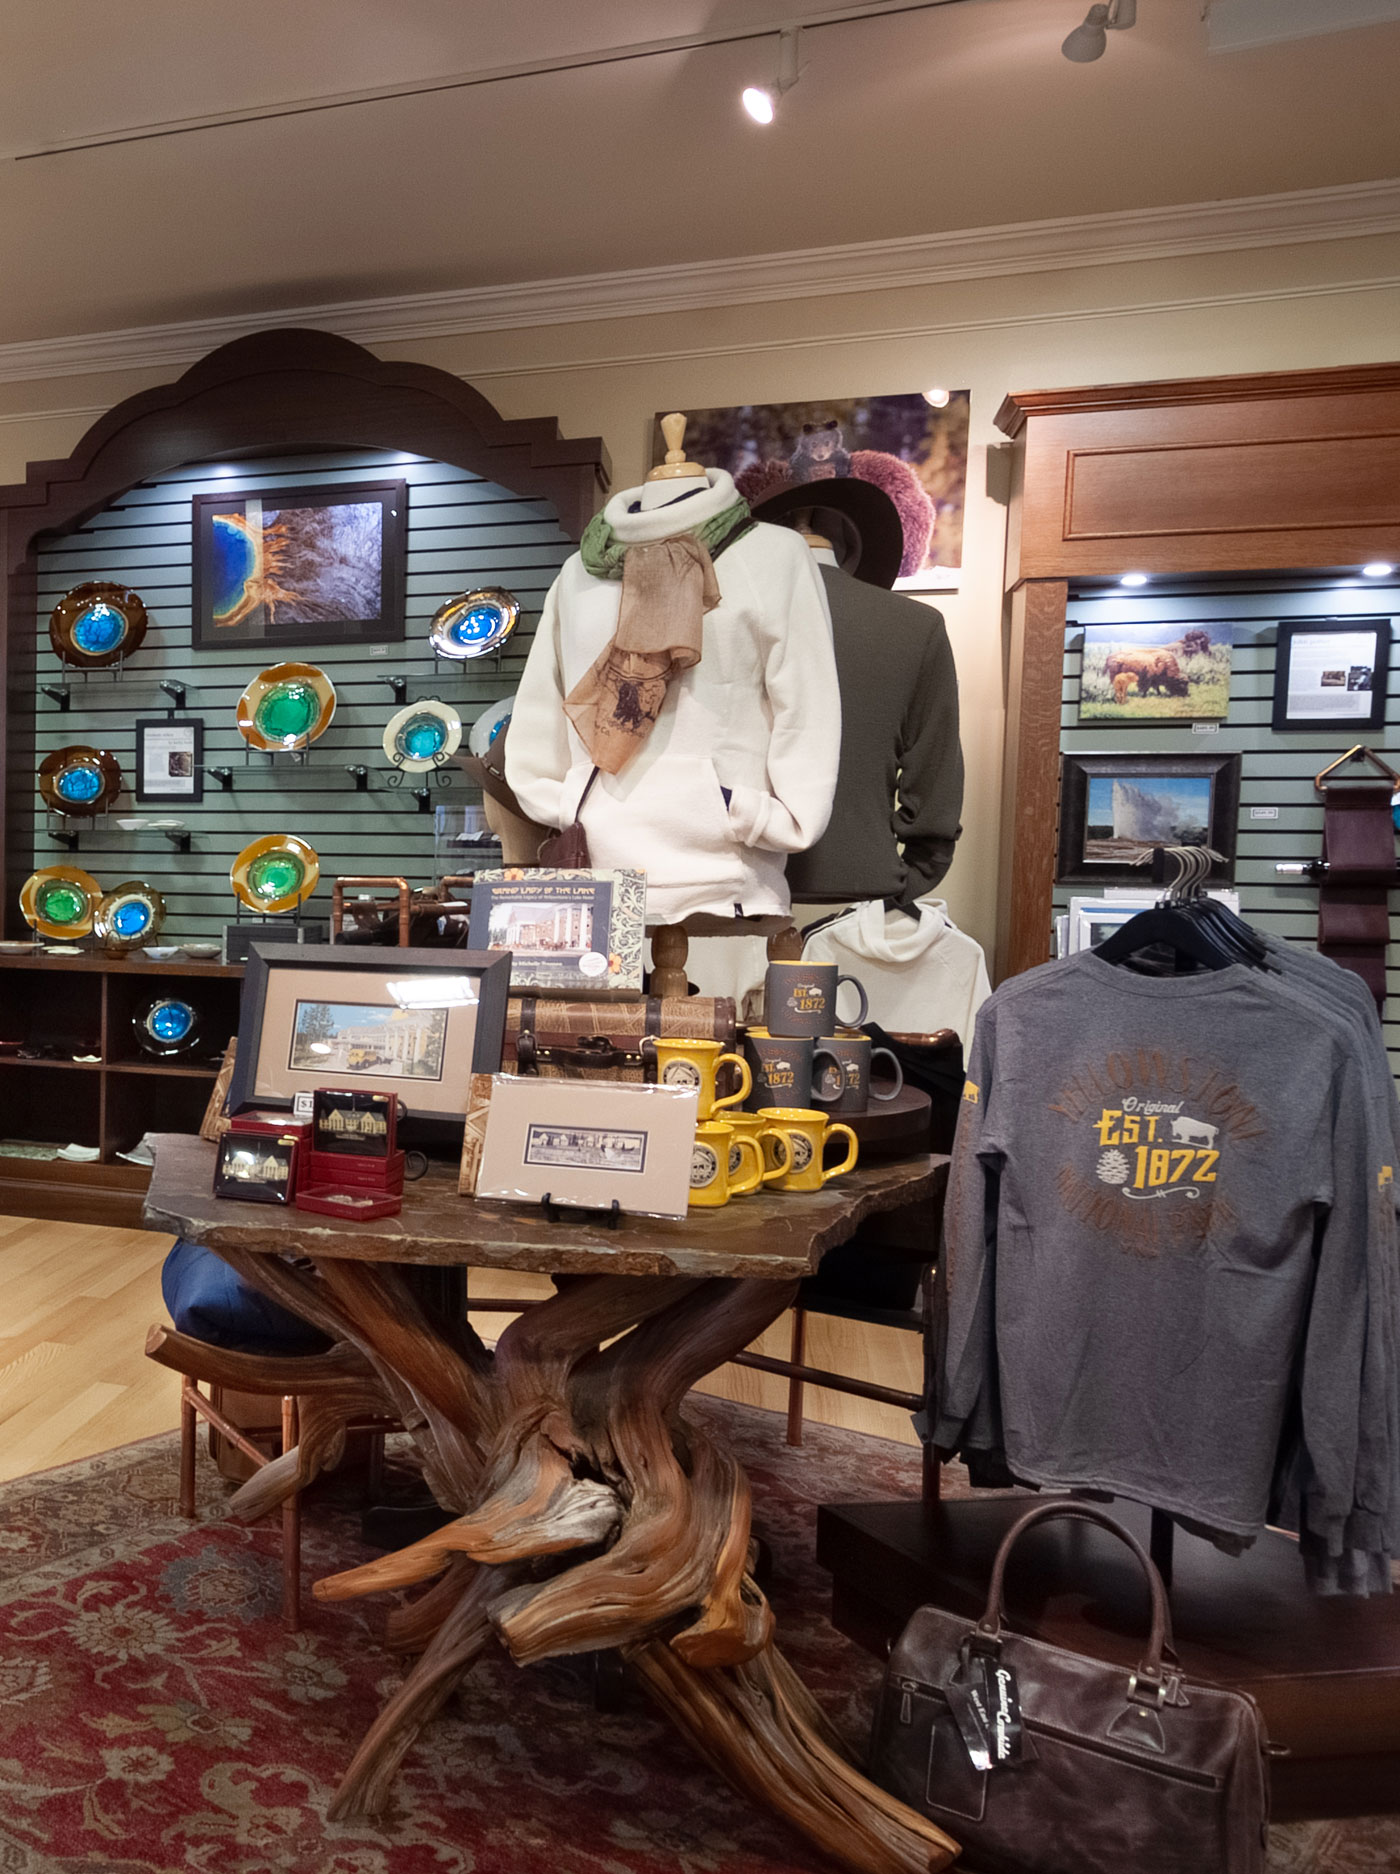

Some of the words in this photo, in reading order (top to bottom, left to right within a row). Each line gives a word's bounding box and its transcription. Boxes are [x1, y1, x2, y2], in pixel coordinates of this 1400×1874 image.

[800, 997, 825, 1009] 1872
[768, 1071, 794, 1085] 1872
[1048, 1048, 1267, 1146] YELLOWSTON
[1121, 1096, 1185, 1116] Original
[1092, 1108, 1163, 1146] EST.
[1132, 1145, 1220, 1189] 1872
[995, 1669, 1012, 1713] Genuine
[996, 1711, 1011, 1759] Cowhide
